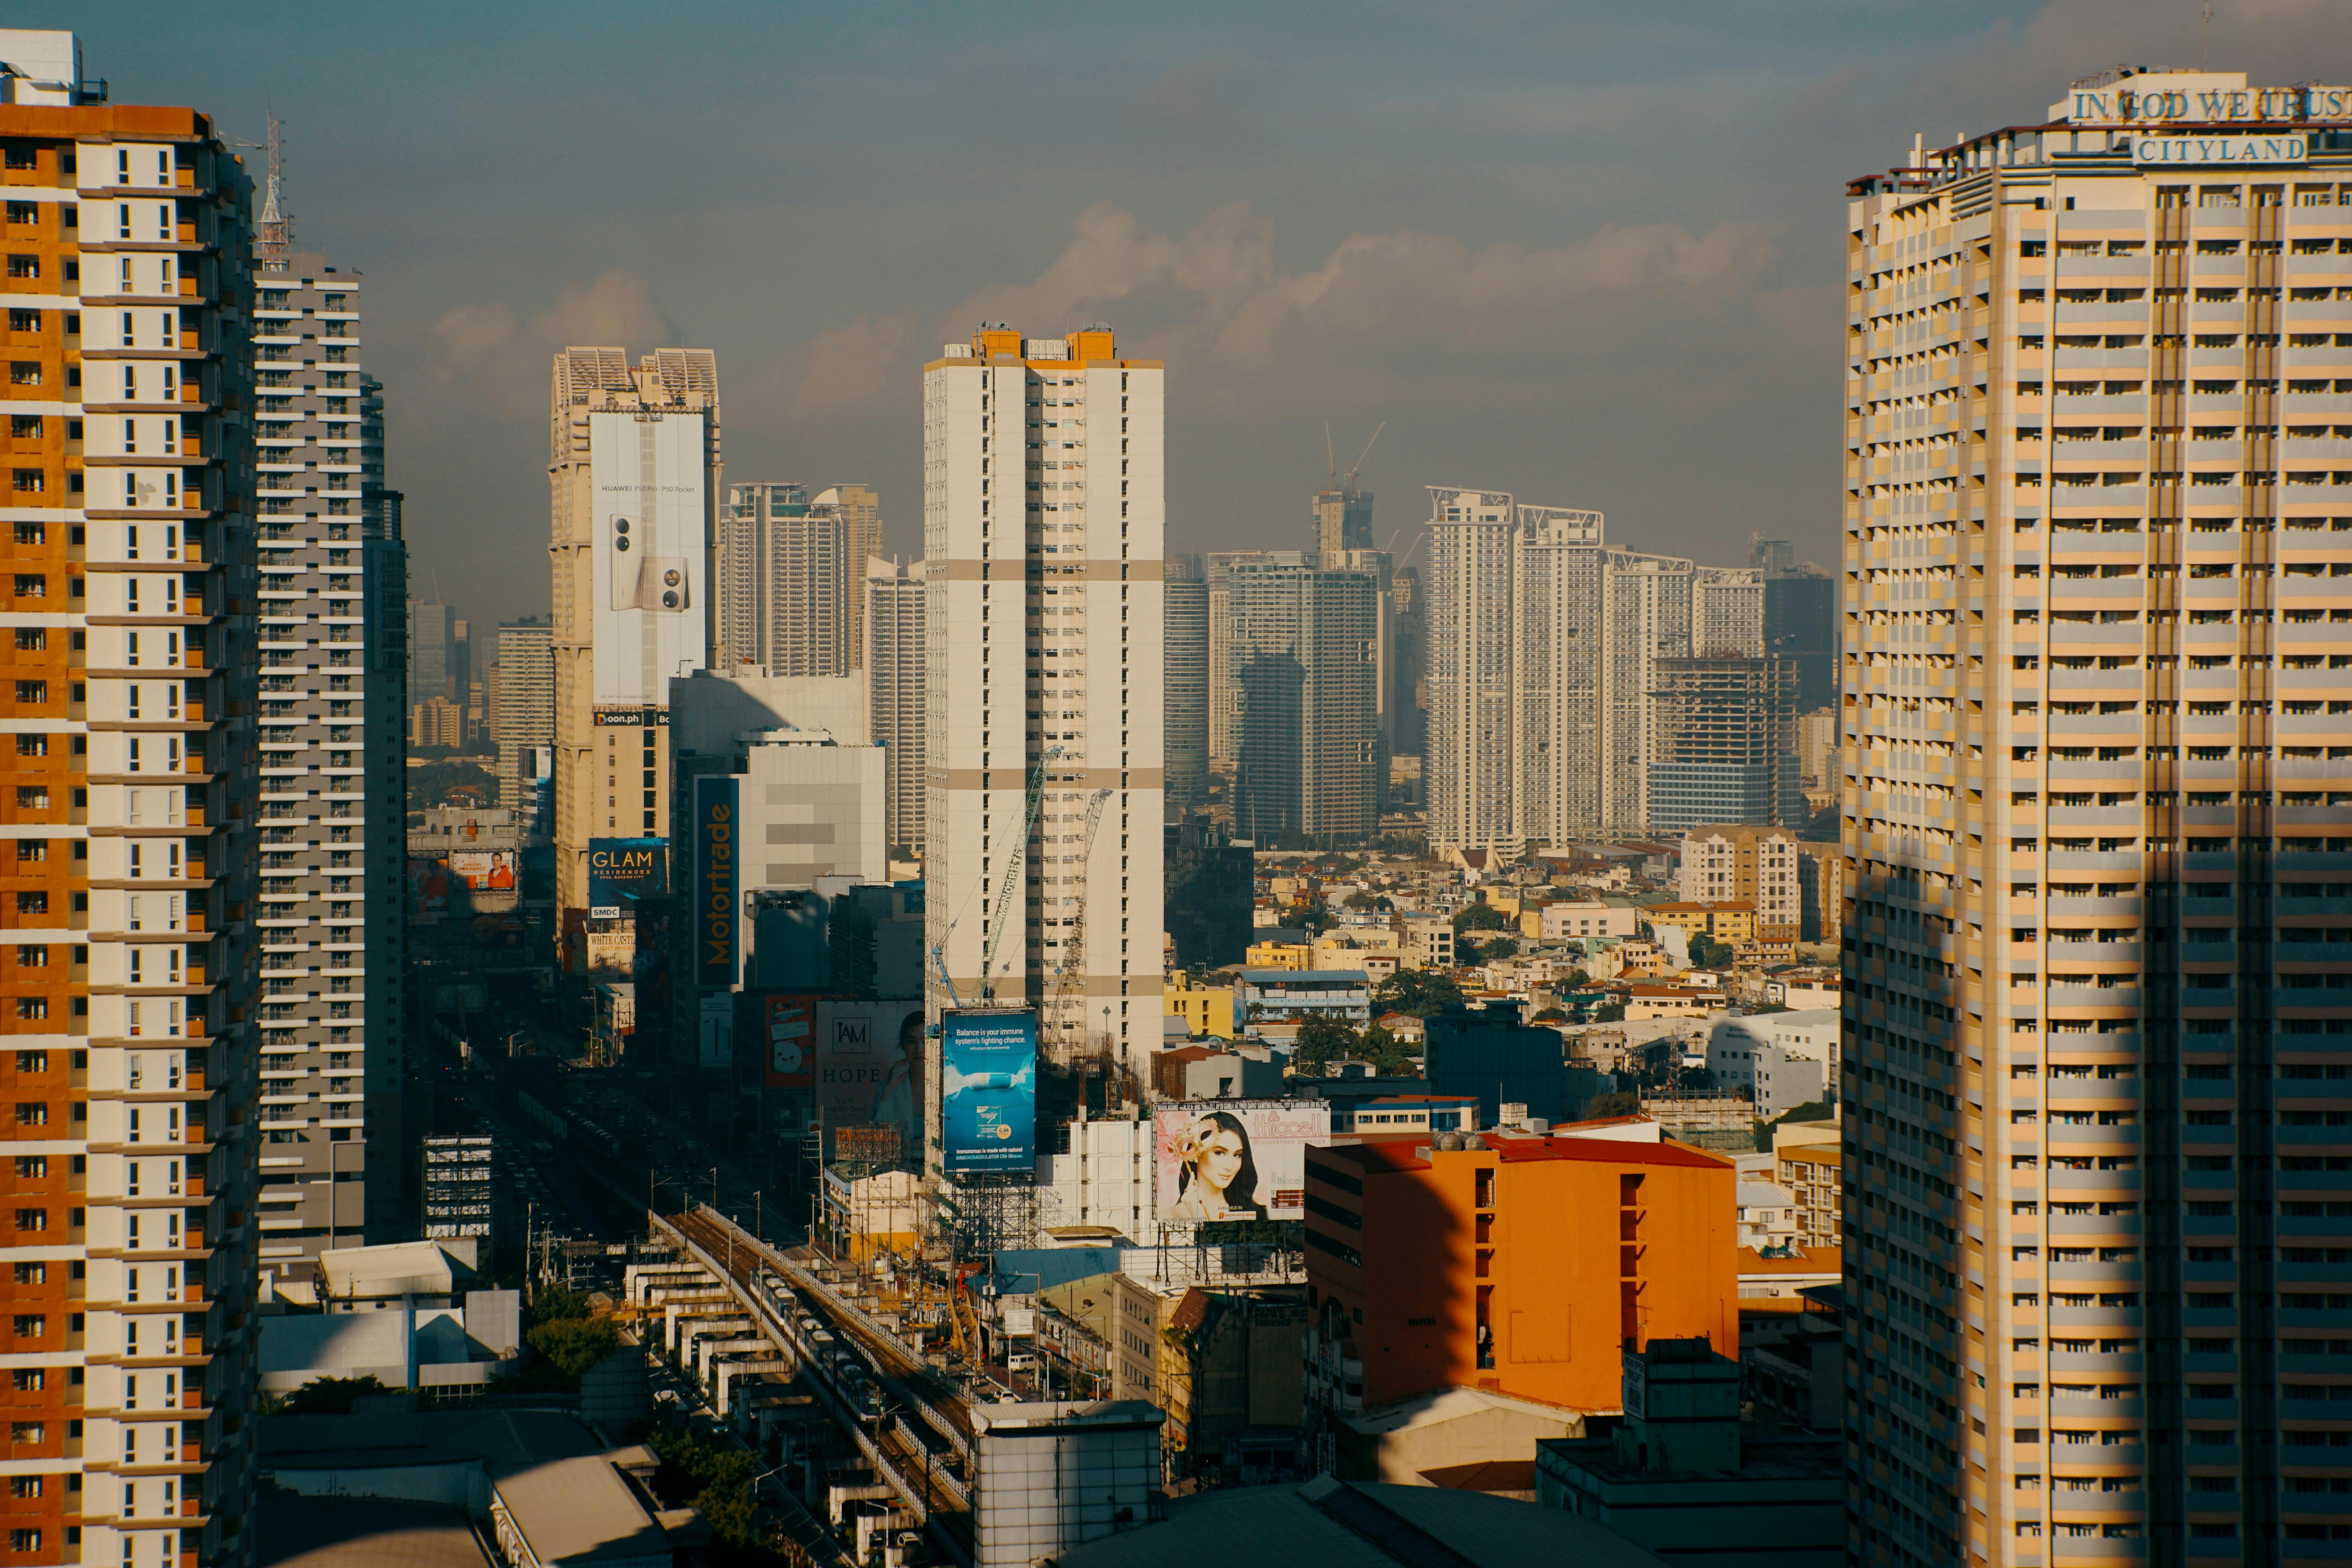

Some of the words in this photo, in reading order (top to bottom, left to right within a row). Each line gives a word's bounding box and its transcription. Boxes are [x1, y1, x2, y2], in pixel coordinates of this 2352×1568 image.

[2074, 93, 2107, 118] IN
[2117, 93, 2188, 118] GOD
[2198, 92, 2249, 117] WE
[2138, 140, 2305, 160] CITYLAND
[592, 851, 652, 867] GLAM
[706, 804, 730, 964] Motortrade
[591, 936, 613, 945] WHITE
[614, 935, 635, 945] CASTL
[594, 953, 618, 964] Dapat
[955, 1037, 980, 1046] system's
[981, 1037, 1003, 1045] fighting
[822, 1069, 880, 1082] HOPE
[1253, 1111, 1323, 1136] thiocell
[1278, 1176, 1303, 1185] thiocell
